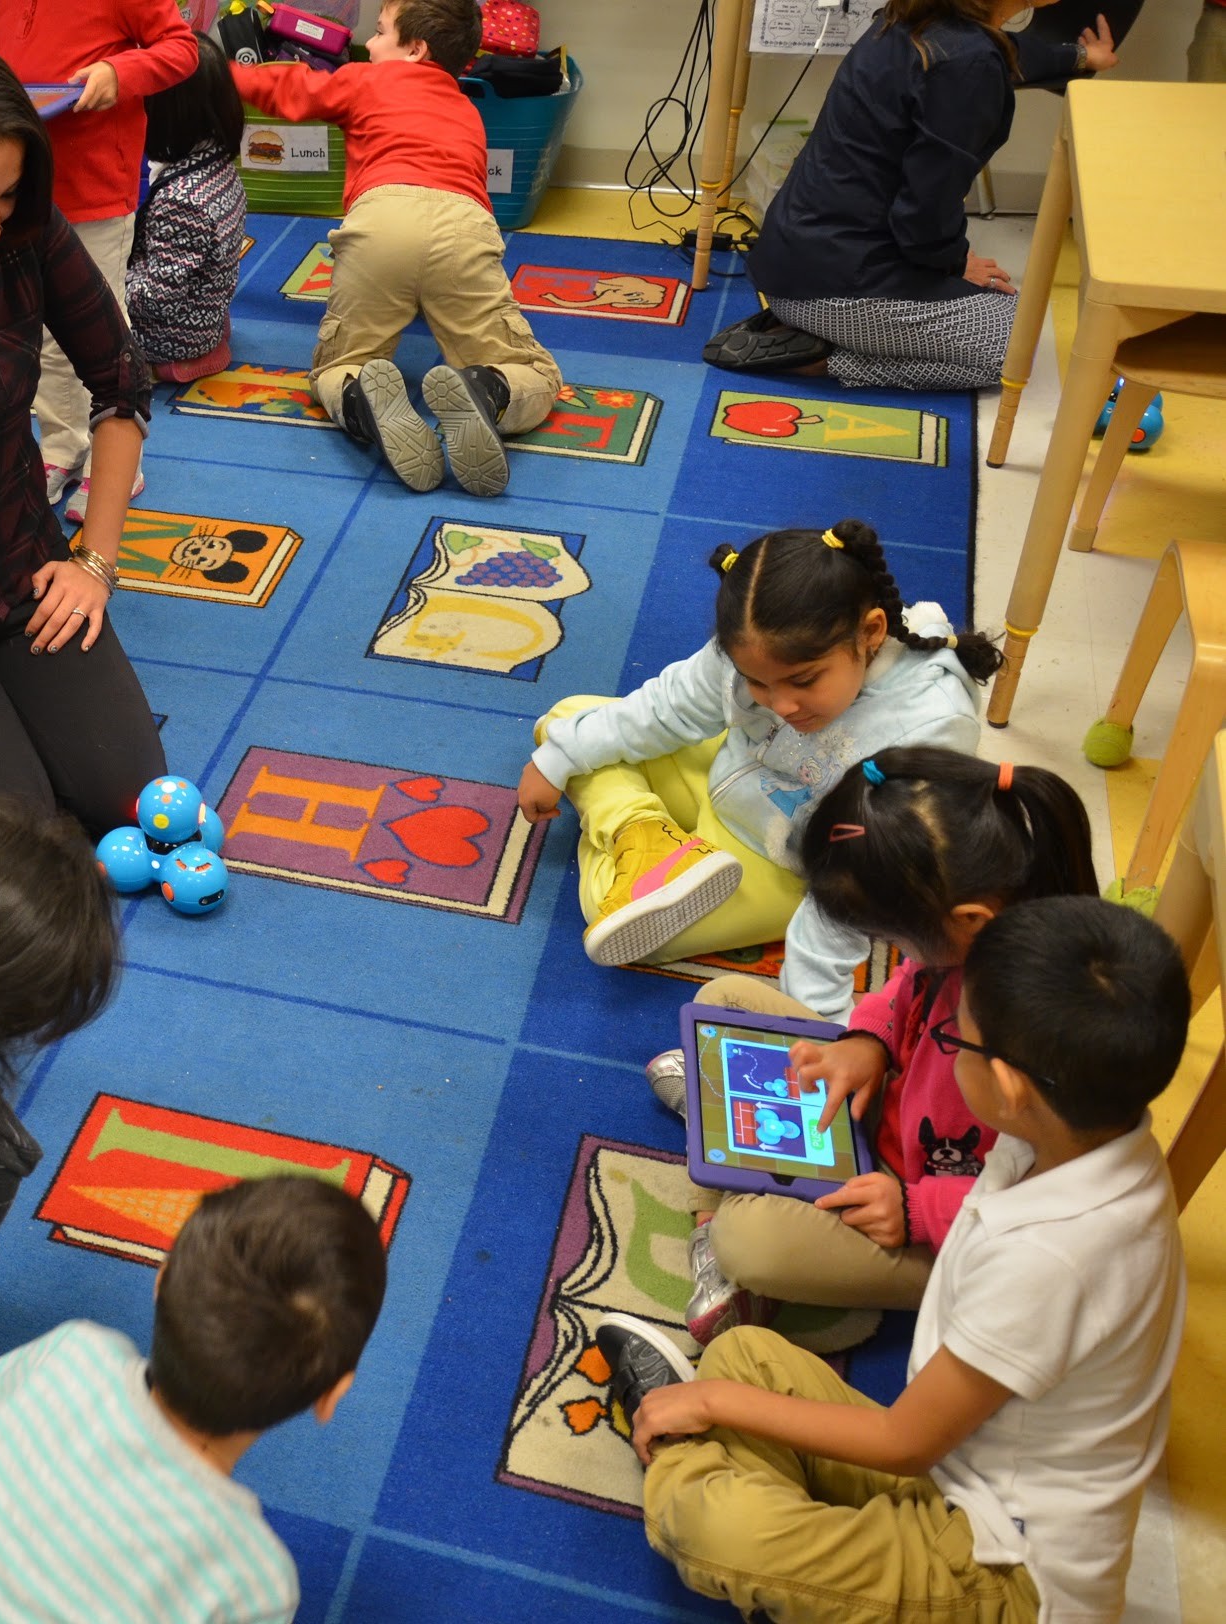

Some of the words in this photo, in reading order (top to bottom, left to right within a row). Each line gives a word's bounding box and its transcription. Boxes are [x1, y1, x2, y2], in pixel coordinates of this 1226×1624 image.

[291, 148, 326, 158] Lunch
[516, 269, 599, 296] E
[534, 410, 618, 449] F
[824, 406, 911, 443] A
[402, 596, 545, 661] G
[226, 765, 387, 862] H
